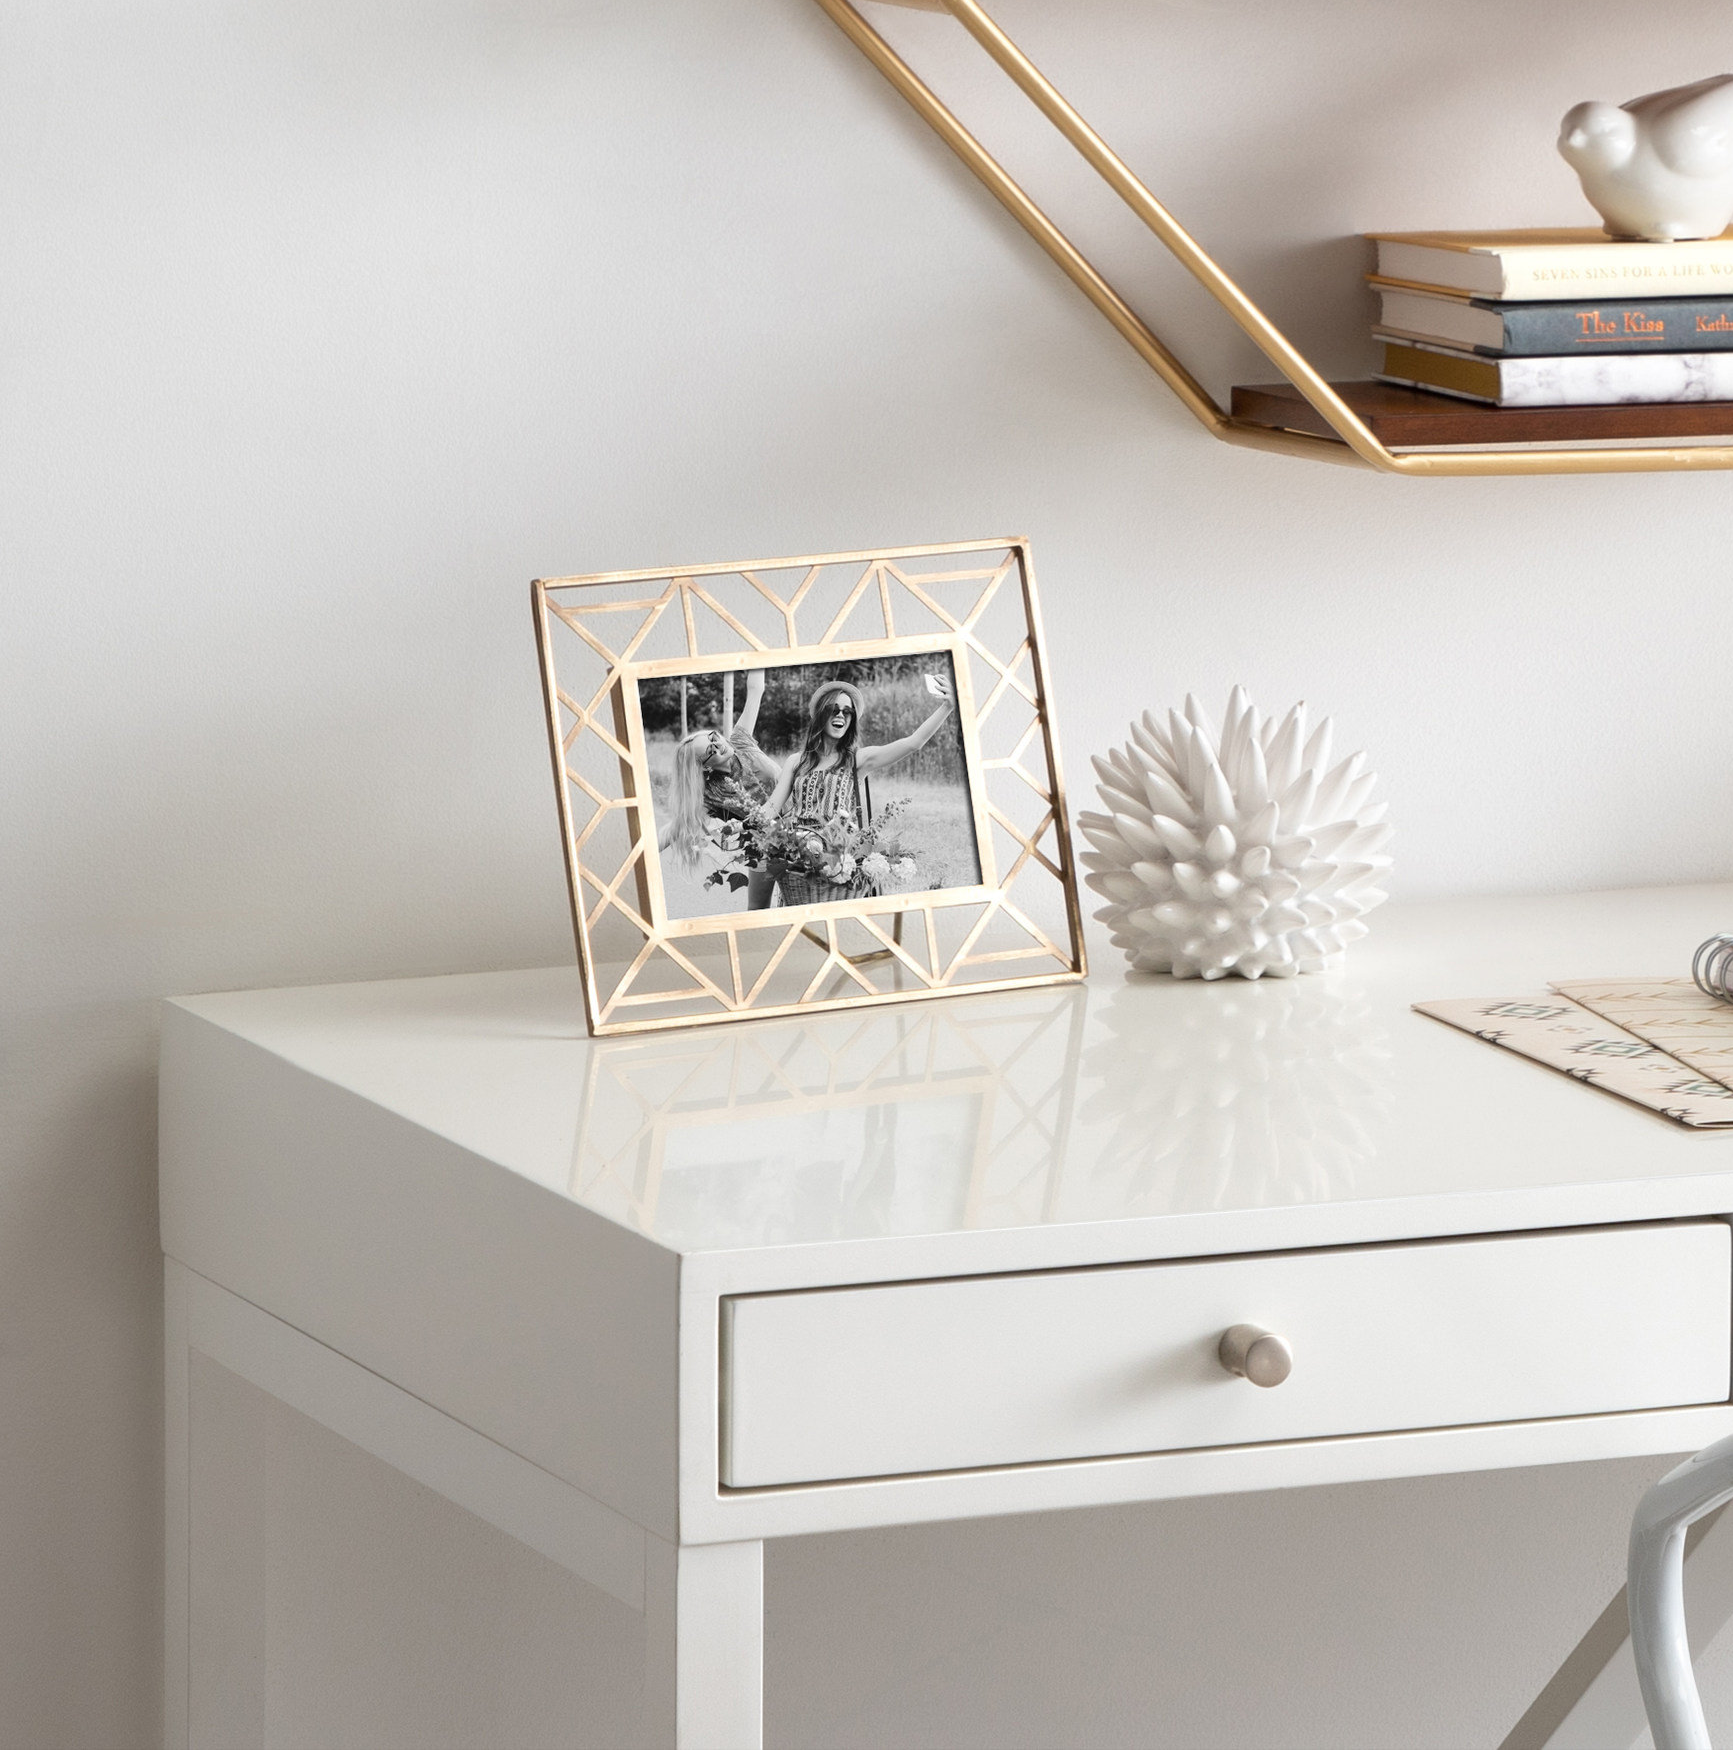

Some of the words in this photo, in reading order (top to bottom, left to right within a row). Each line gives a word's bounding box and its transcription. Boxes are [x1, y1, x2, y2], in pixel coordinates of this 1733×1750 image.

[1532, 268, 1580, 281] SEVEN
[1584, 266, 1618, 279] SINS
[1622, 265, 1652, 278] FOR
[1658, 265, 1667, 277] A
[1672, 263, 1705, 277] LIFE
[1576, 310, 1616, 334] The
[1623, 311, 1664, 333] Kiss
